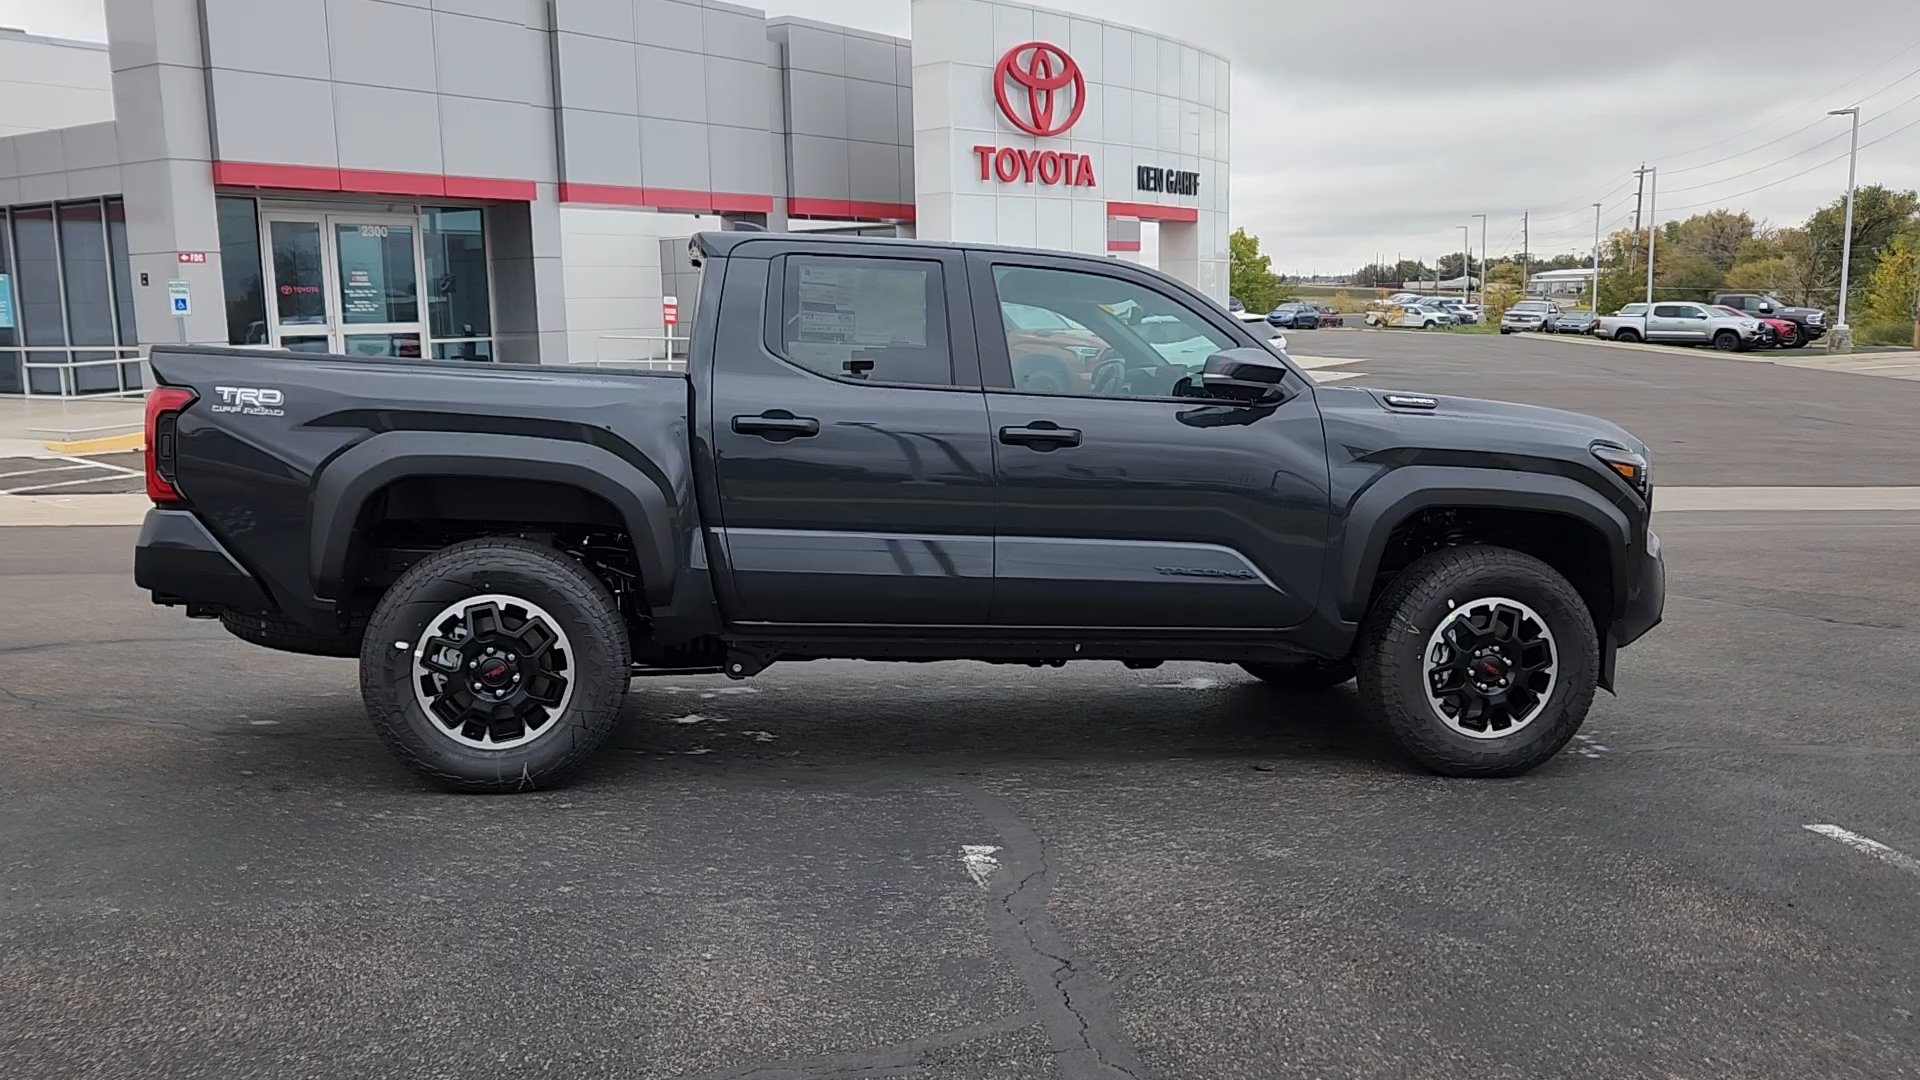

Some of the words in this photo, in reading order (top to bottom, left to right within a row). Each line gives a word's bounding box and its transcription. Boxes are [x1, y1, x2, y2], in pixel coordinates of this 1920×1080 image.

[973, 145, 1096, 187] TOYOTA
[1137, 165, 1164, 193] KEN
[361, 225, 388, 238] 2300
[293, 285, 320, 294] TOYOTA
[215, 386, 284, 406] TRD
[1153, 566, 1258, 580] TACOMA
[484, 664, 506, 678] TRD
